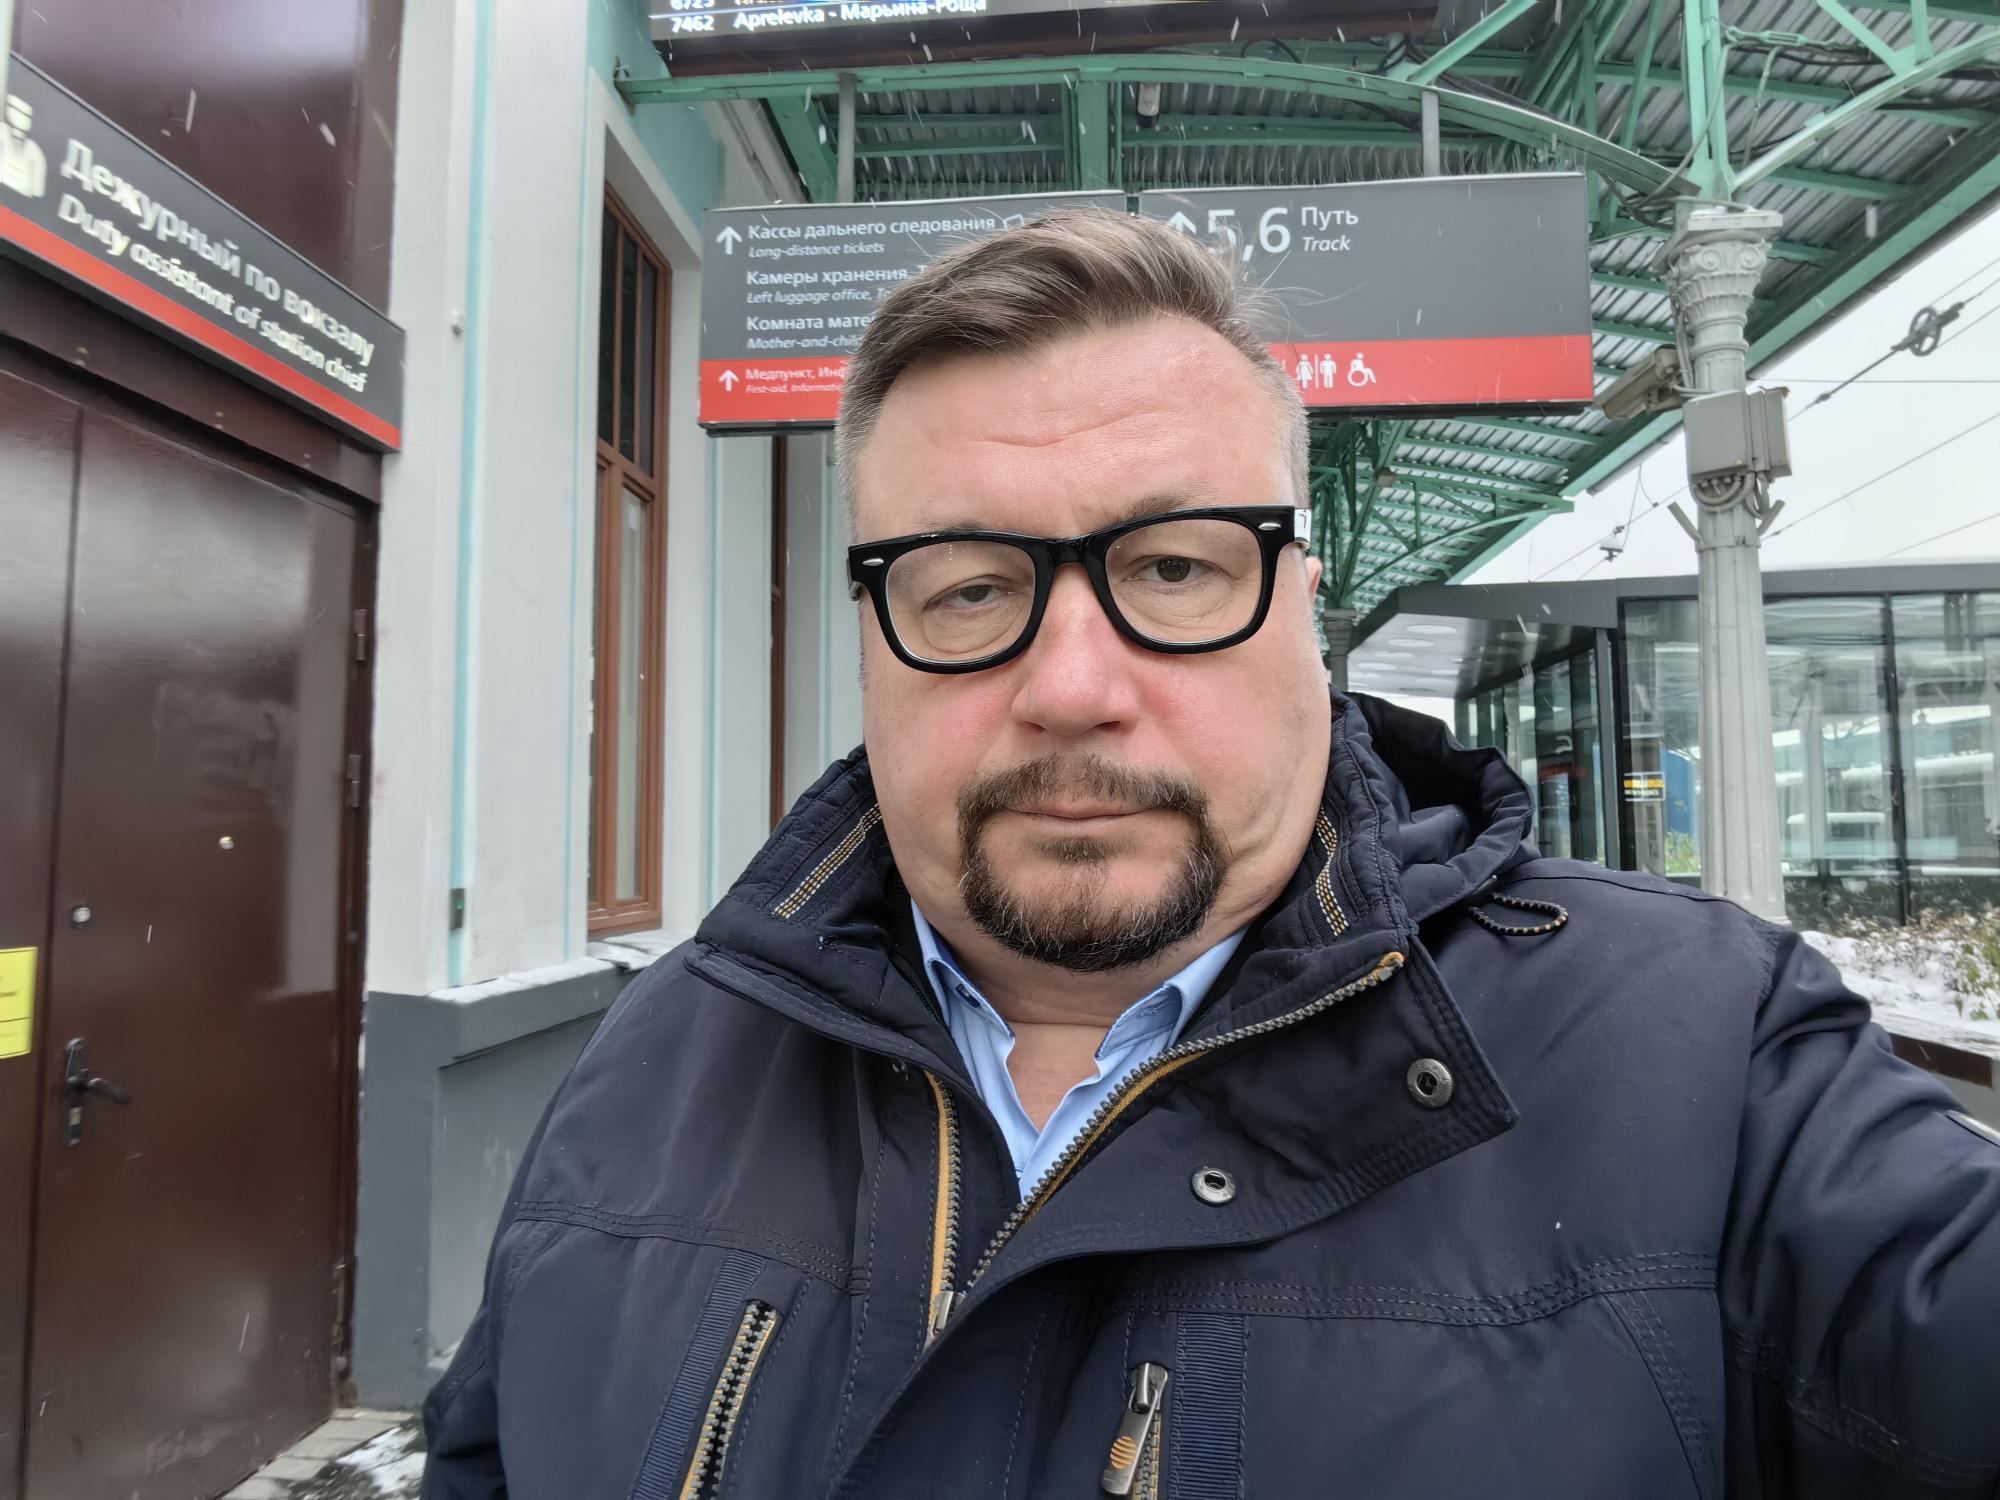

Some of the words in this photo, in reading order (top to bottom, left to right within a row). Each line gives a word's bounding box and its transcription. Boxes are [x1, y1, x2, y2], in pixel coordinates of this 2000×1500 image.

[670, 15, 714, 33] 7462
[733, 6, 825, 31] Aprelevka
[748, 225, 801, 239] Кассы
[804, 222, 886, 239] дальнего
[890, 217, 995, 235] следования
[1301, 206, 1359, 231] Путь
[60, 138, 241, 278] Дежурный
[245, 263, 281, 301] по
[283, 288, 375, 367] вокзалу
[748, 244, 840, 260] Long-distance
[844, 242, 885, 255] tickets
[1302, 235, 1351, 252] Track
[746, 271, 818, 287] Камеры
[57, 193, 131, 256] Duty
[130, 243, 235, 316] assistant
[234, 305, 262, 329] of
[259, 320, 325, 369] station
[325, 357, 368, 392] chief
[747, 292, 773, 304] Left
[775, 290, 832, 305] luggage
[746, 316, 824, 331] Комната
[827, 315, 877, 329] мате
